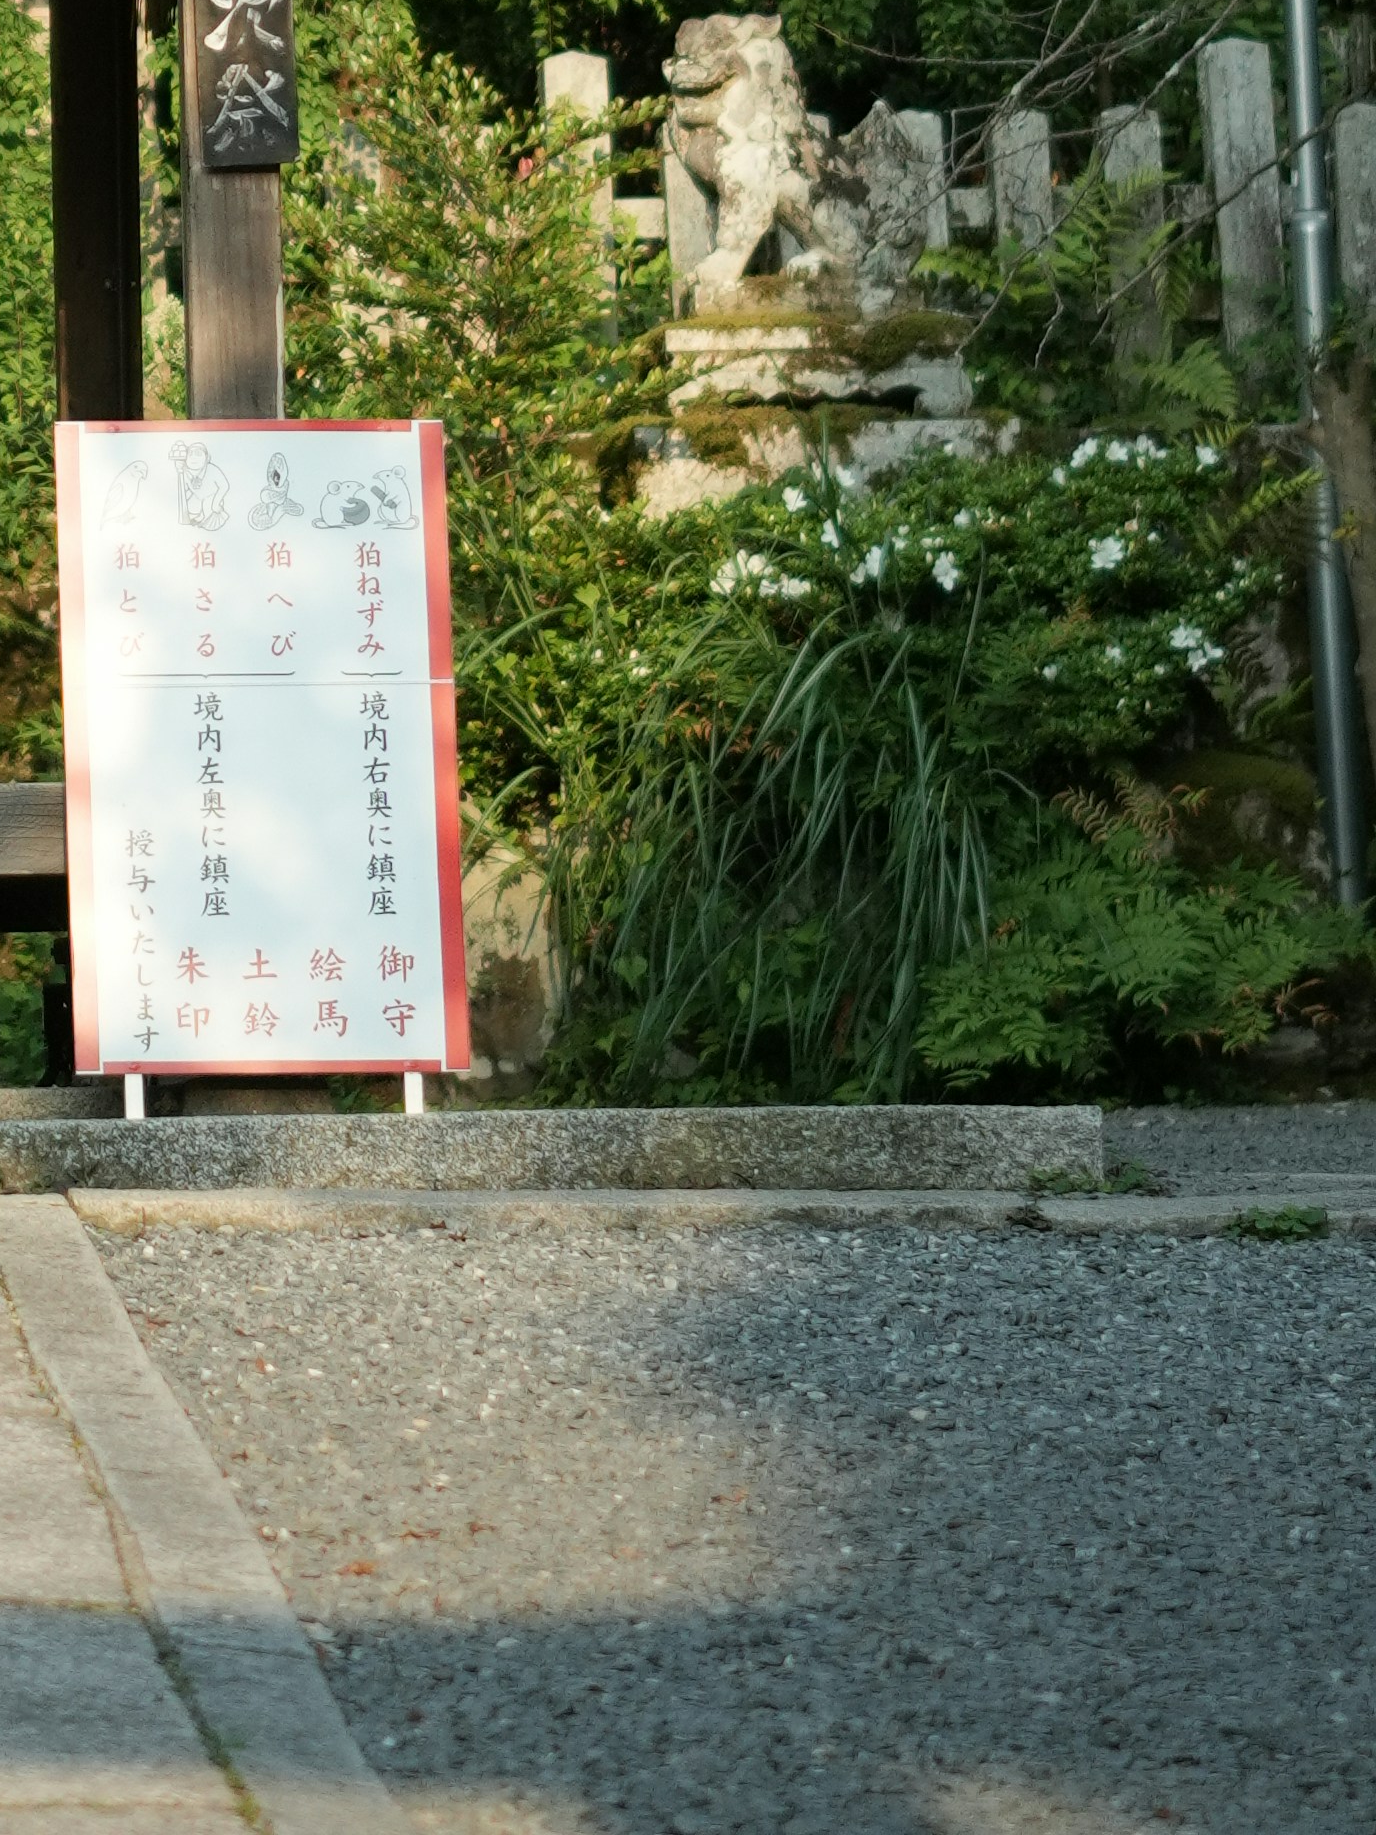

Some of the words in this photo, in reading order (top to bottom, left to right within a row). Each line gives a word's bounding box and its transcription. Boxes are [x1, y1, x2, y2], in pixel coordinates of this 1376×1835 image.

[115, 541, 145, 657] 狛とび
[191, 541, 217, 658] 狛さる
[266, 541, 296, 657] 狛へび
[353, 541, 385, 658] 狛ねずみ
[193, 692, 230, 918] 境内左奥に鎮座
[359, 691, 397, 916] 境内右奥に鎮座
[125, 829, 160, 1053] 授与いたします
[176, 946, 211, 1038] 朱印
[242, 946, 280, 1037] 土鈴
[309, 946, 348, 1037] 絵馬
[377, 944, 417, 1037] 御守
